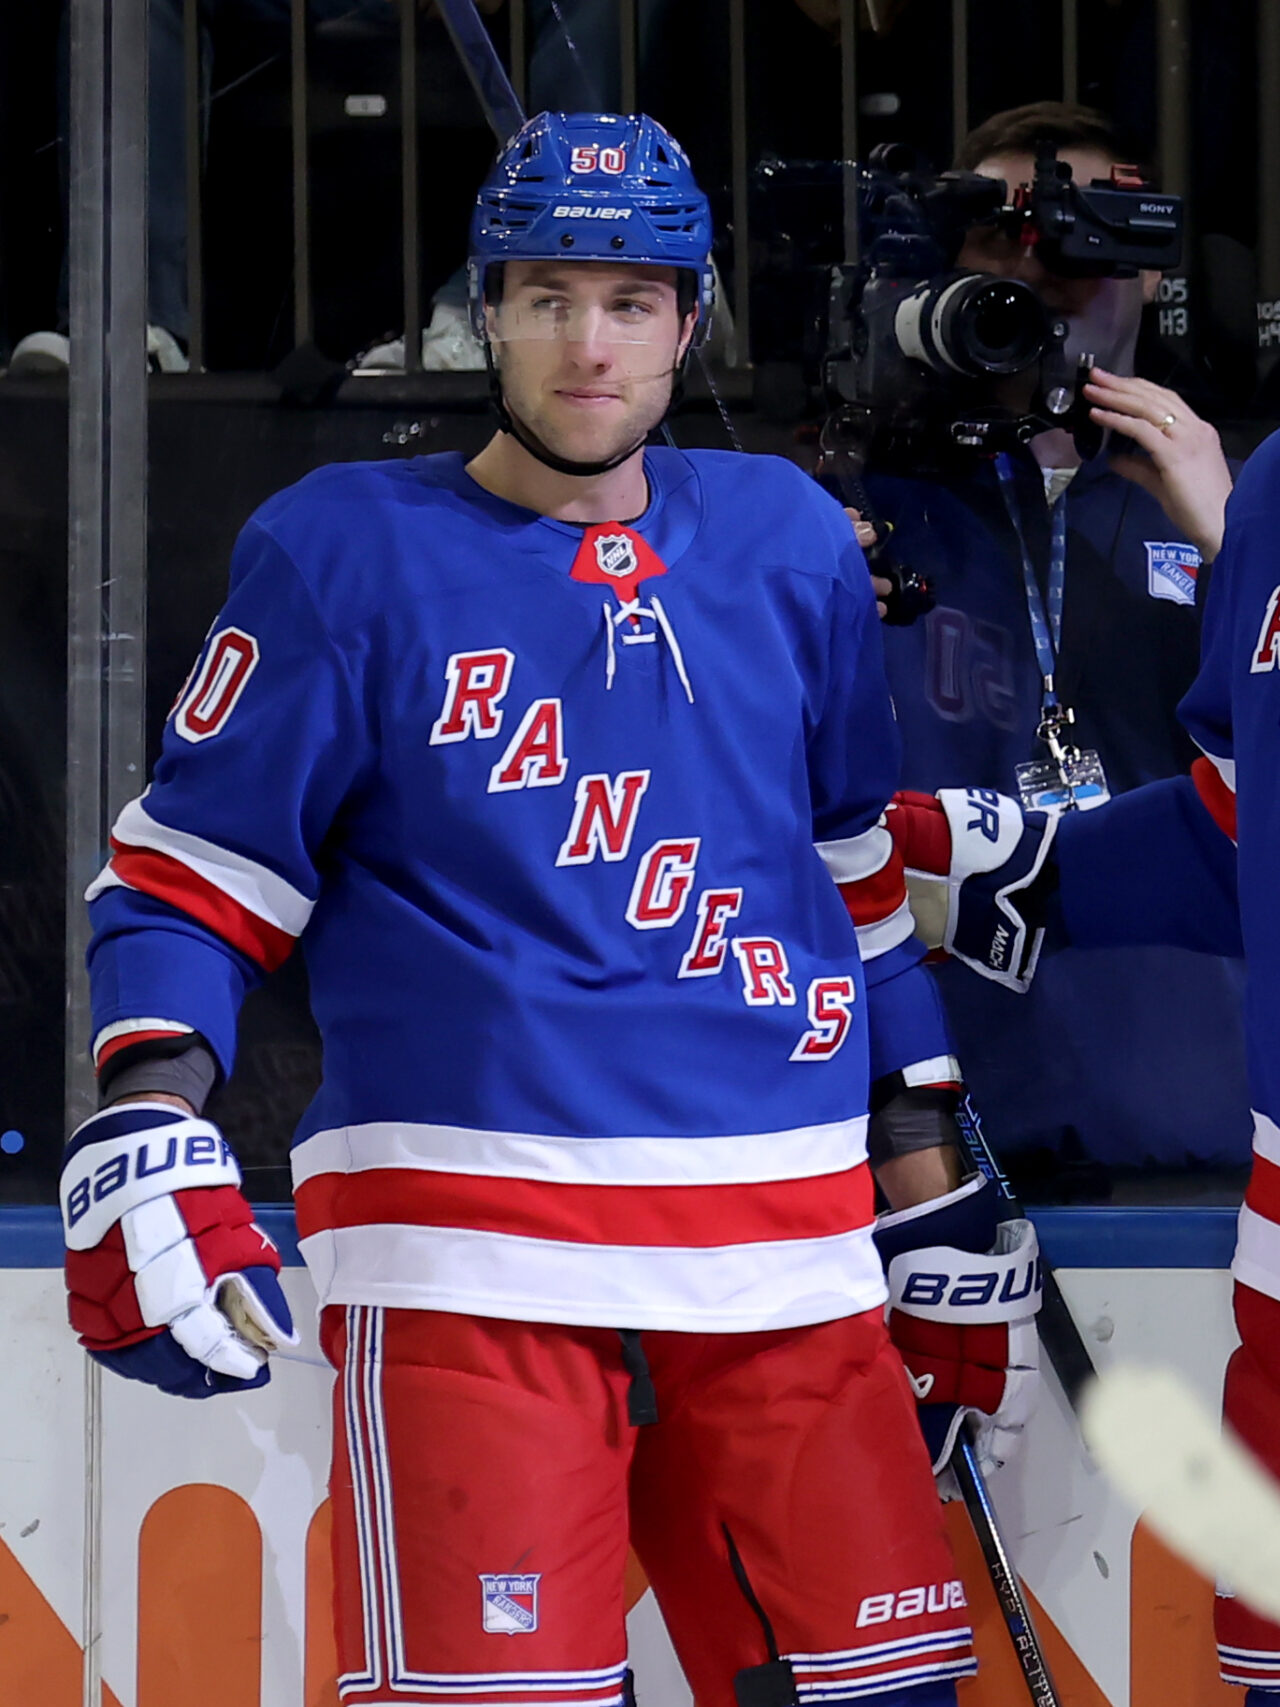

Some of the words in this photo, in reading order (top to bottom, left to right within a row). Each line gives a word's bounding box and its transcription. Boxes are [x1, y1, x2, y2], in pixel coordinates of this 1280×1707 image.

[571, 147, 626, 174] 50
[552, 205, 632, 220] BAUER
[1139, 203, 1174, 214] SONY
[1156, 278, 1187, 303] 05
[1159, 308, 1188, 336] H3
[1152, 549, 1177, 560] NEW
[1179, 551, 1199, 565] YOR
[167, 616, 260, 744] 0
[429, 647, 855, 1062] RANGERS
[900, 1256, 1043, 1306] BAU
[486, 1581, 507, 1592] NEW
[508, 1581, 533, 1592] YORK
[492, 1595, 533, 1627] RANGERS
[855, 1580, 968, 1629] BAUE
